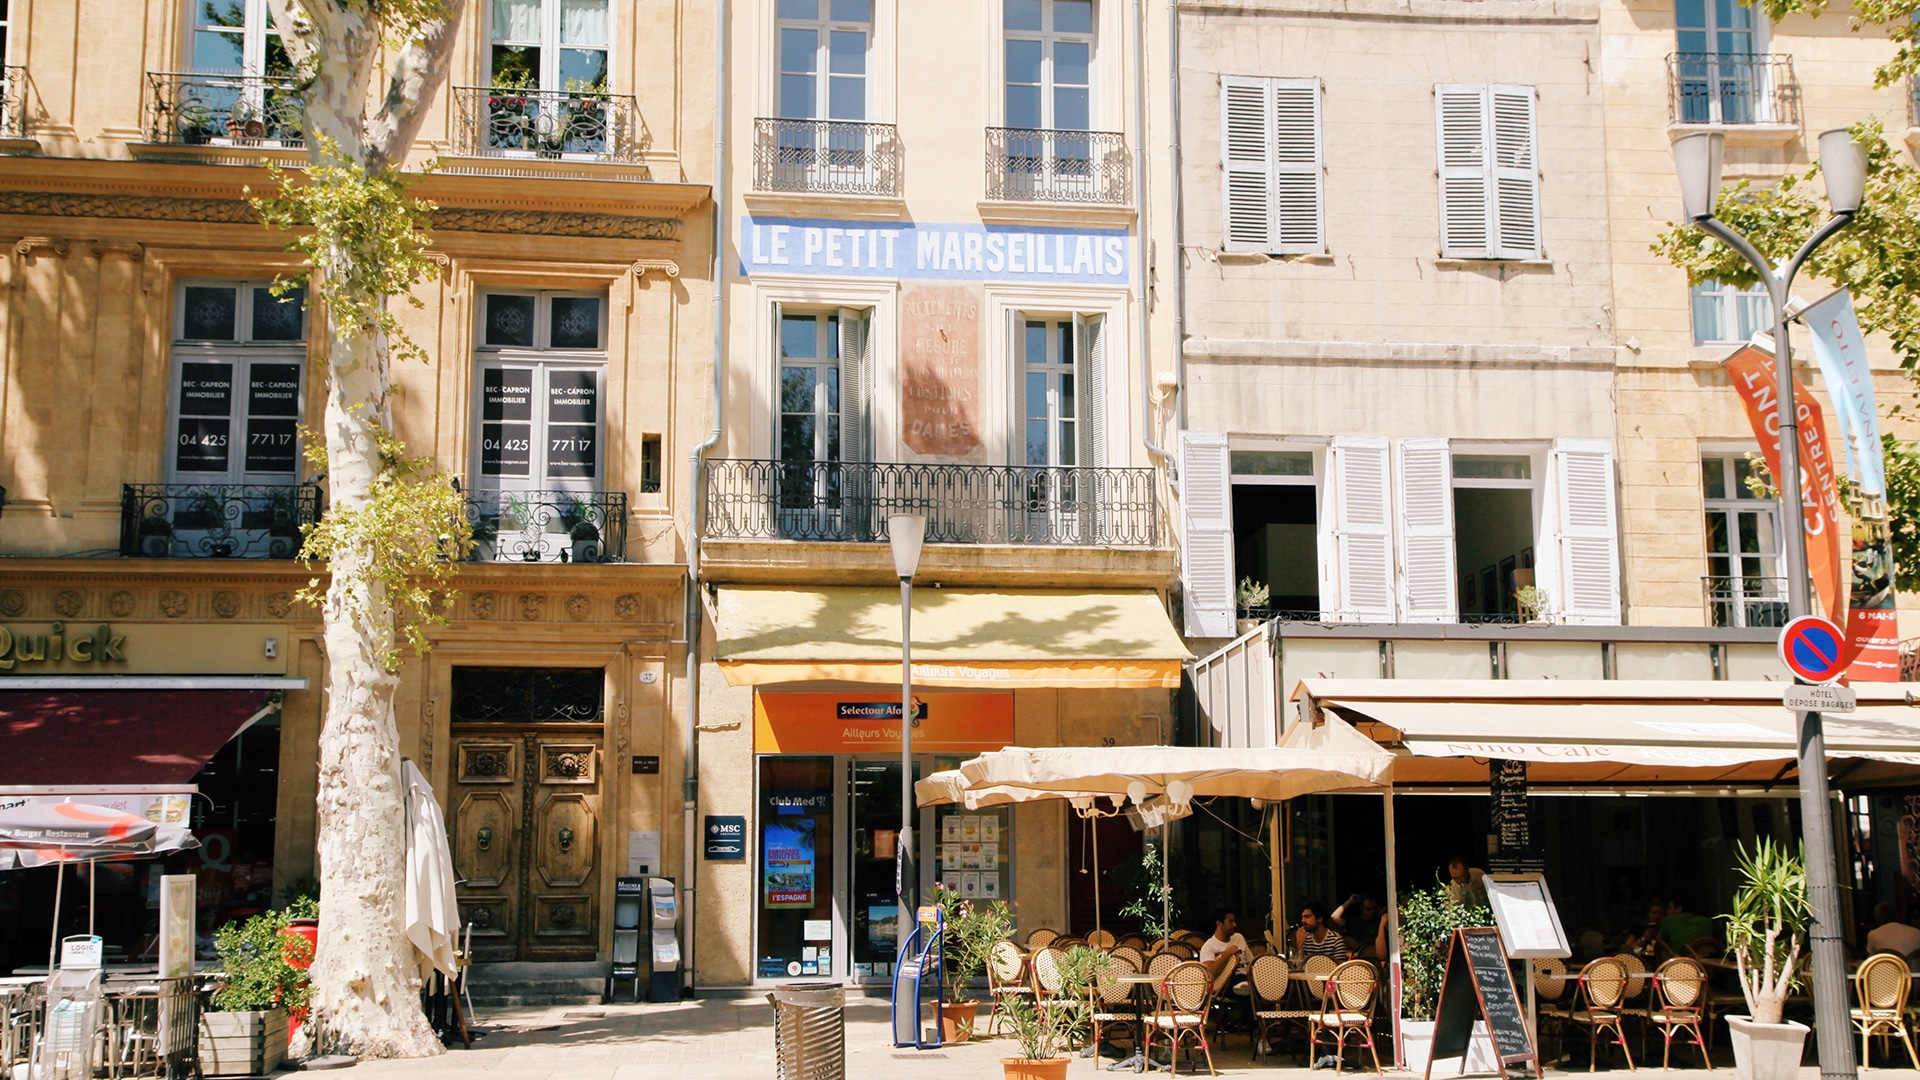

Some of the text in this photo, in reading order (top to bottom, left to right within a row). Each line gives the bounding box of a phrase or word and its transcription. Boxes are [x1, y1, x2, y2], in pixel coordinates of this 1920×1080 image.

[752, 224, 1124, 276] LE PETIT MARSEILLAIS
[915, 338, 967, 355] MESURE
[183, 381, 196, 389] BEC
[200, 380, 230, 389] CAPRON
[251, 381, 265, 389] BEC
[268, 381, 298, 389] CAPRON
[502, 385, 531, 394] CAPRON
[186, 391, 225, 399] IMMOBILIER
[550, 387, 563, 395] BEC
[567, 387, 595, 395] CAPRON
[489, 396, 526, 404] IMMOBILIER
[554, 398, 591, 406] IMMOBILIER
[923, 405, 959, 415] POUR
[910, 418, 972, 440] DAMES
[179, 433, 227, 447] 04 425
[251, 433, 292, 445] 771 17
[483, 438, 529, 451] 04 425
[552, 439, 591, 452] 771 17
[1803, 425, 1839, 523] CENTRE
[1858, 611, 1866, 620] 6
[642, 673, 653, 681] 37
[911, 666, 1010, 680] Ailleurs Voyages
[1810, 689, 1833, 699] HÔTEL
[1789, 699, 1854, 709] DÉPOSE BAGAGES
[841, 705, 903, 715] Selectour Afa
[842, 728, 925, 740] Ailleurs Voyes
[1102, 737, 1116, 747] 39
[769, 796, 815, 806] Club Med
[720, 824, 741, 833] MSC
[14, 829, 42, 839] Burger
[45, 829, 90, 839] Restaurant
[197, 833, 233, 873] Q
